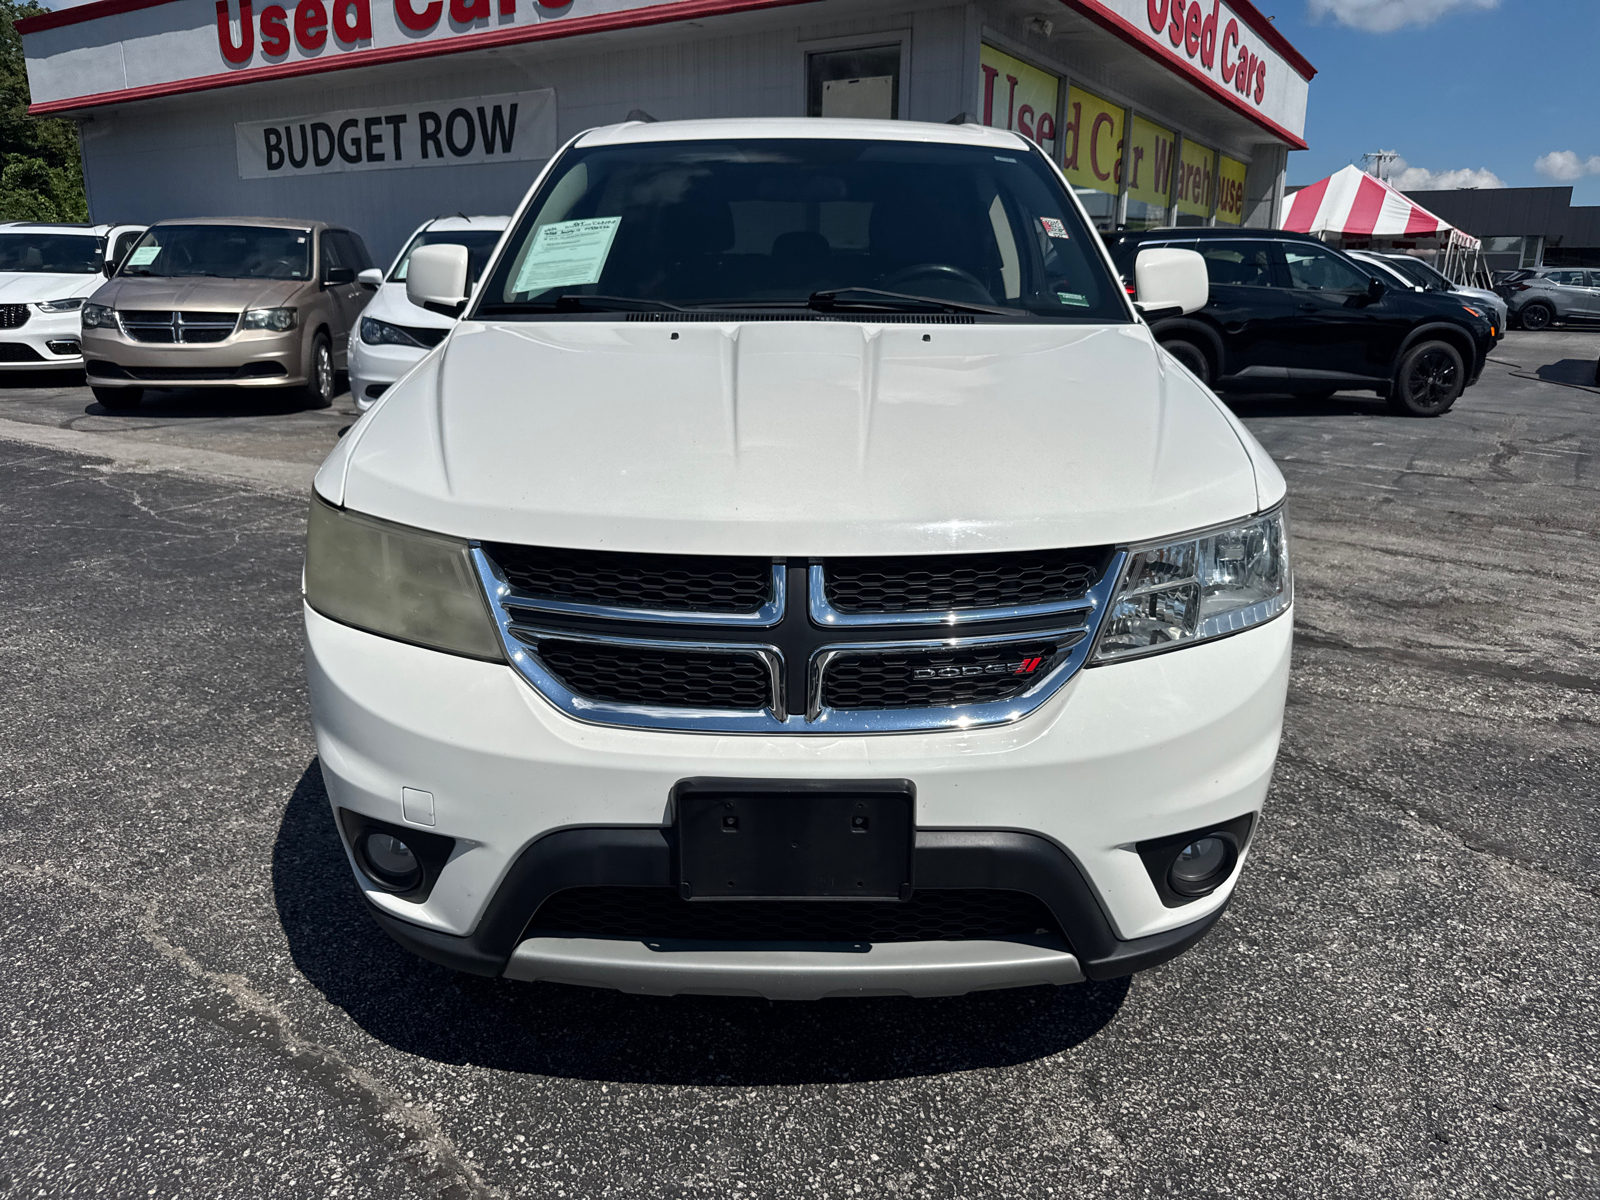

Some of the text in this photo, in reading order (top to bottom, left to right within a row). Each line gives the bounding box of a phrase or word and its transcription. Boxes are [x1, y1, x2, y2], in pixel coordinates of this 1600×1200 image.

[216, 0, 574, 63] Used Ca
[1221, 18, 1266, 103] Cars
[263, 103, 518, 171] BUDGET ROW
[1154, 135, 1243, 215] Warehuse
[914, 662, 1026, 678] DODGE
